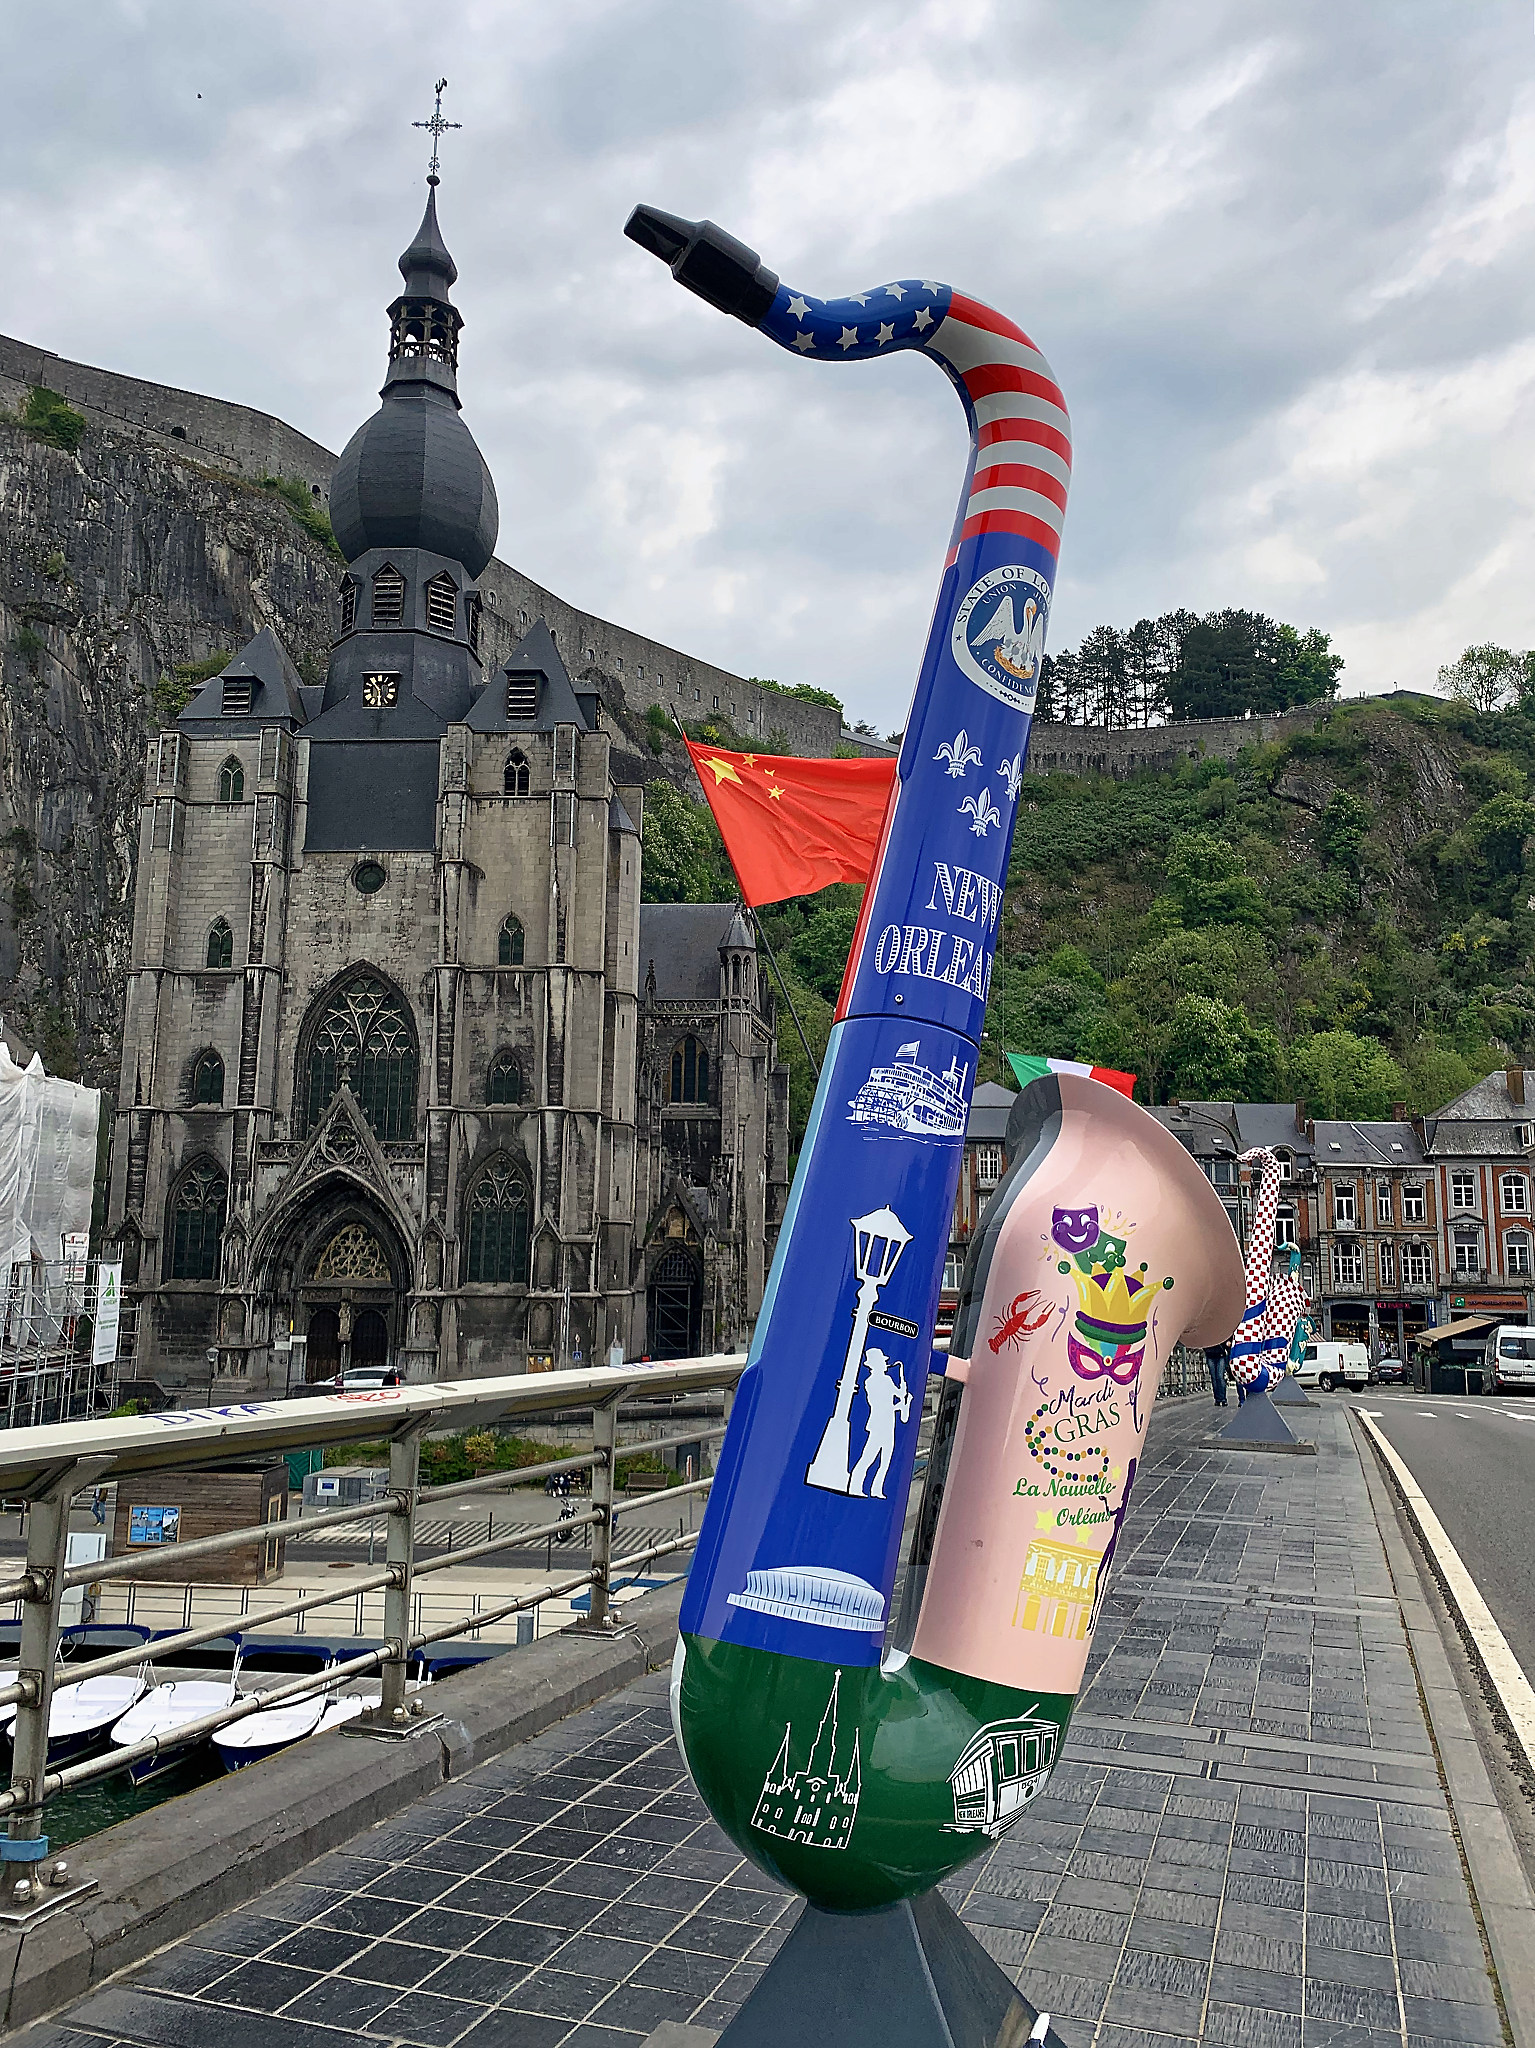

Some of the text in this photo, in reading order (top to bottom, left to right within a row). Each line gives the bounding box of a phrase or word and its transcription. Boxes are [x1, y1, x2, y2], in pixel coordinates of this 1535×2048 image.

[957, 577, 995, 623] STATE
[1002, 567, 1025, 580] OF
[982, 583, 1017, 604] UNION
[924, 861, 1004, 934] NEW
[875, 1315, 916, 1335] BOURBON
[1049, 1378, 1115, 1416] Mardi
[1053, 1402, 1121, 1443] GRAS
[1012, 1477, 1041, 1497] La
[1056, 1507, 1112, 1527] Orléans
